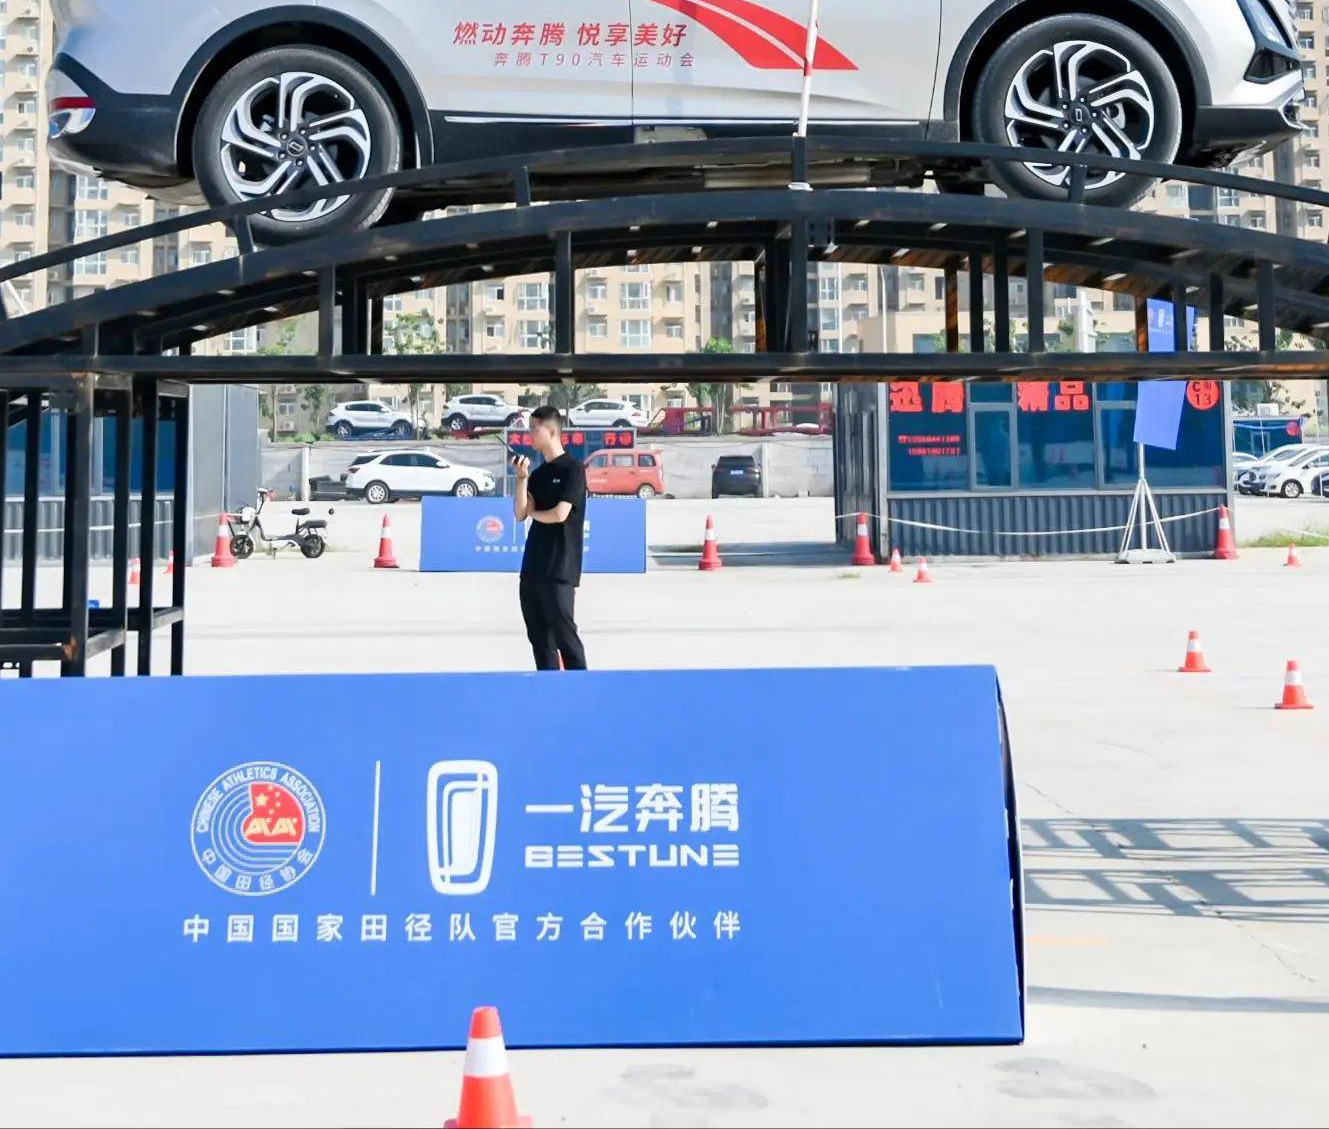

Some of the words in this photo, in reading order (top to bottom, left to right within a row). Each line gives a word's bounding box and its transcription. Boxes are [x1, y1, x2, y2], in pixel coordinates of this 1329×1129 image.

[453, 21, 566, 47] 燃动奔腾
[577, 22, 688, 47] 悦享美好
[525, 783, 739, 833] 一汽奔腾
[524, 844, 740, 868] BESTUNE
[183, 911, 741, 943] 中国国家田径队官方合作伙伴
